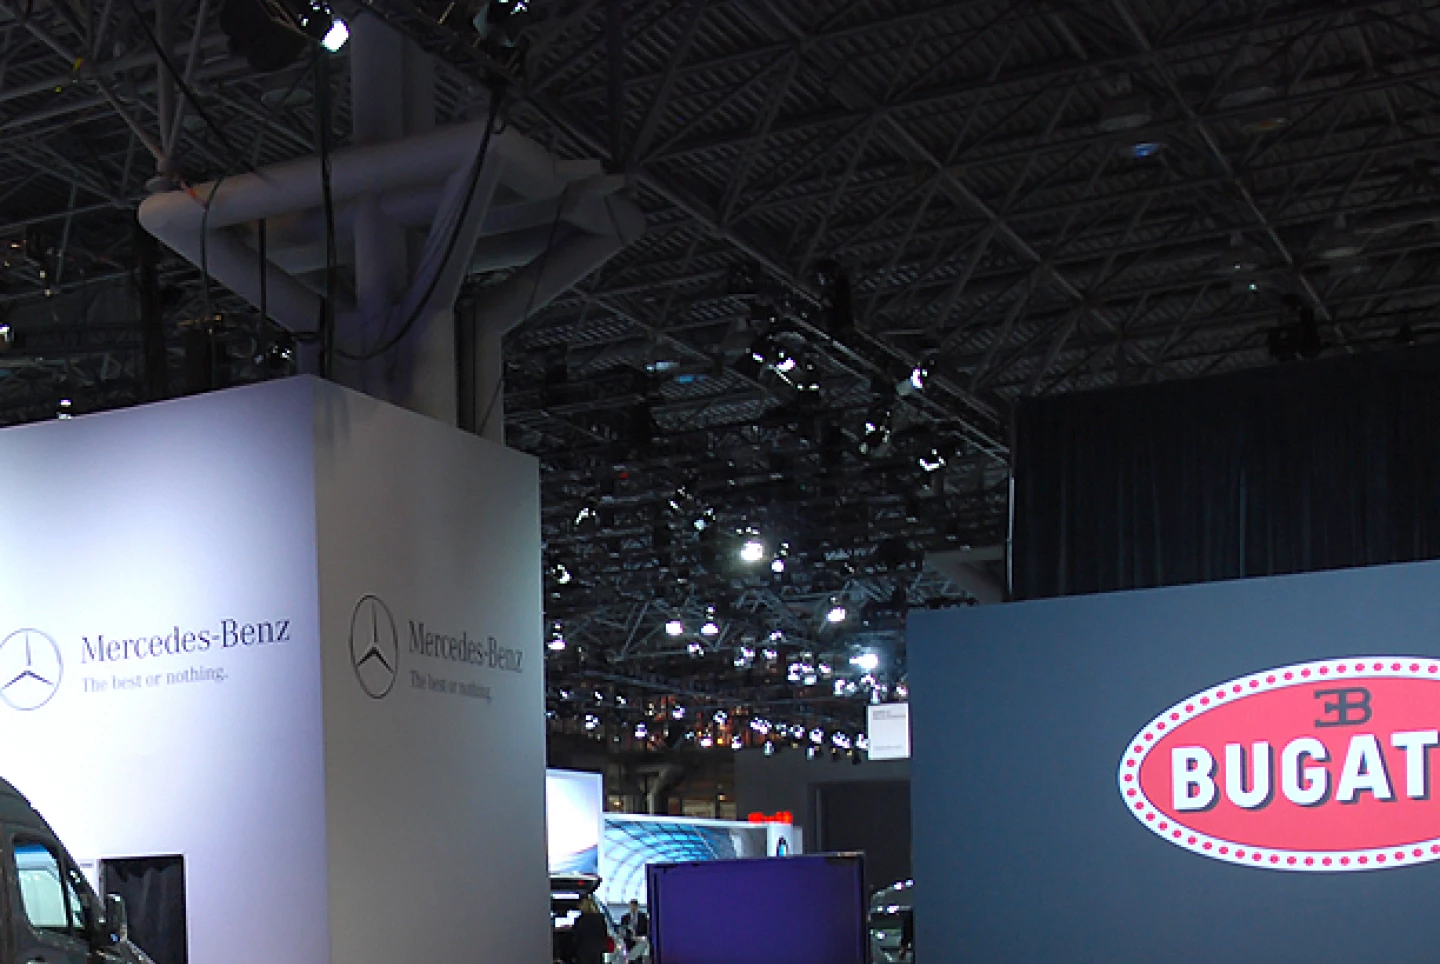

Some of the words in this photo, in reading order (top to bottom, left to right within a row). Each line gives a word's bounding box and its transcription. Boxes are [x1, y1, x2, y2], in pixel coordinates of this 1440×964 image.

[80, 618, 291, 664] Mercedes-Benz
[409, 620, 523, 674] Mercedes-Benz
[82, 677, 108, 692] The
[112, 675, 142, 689] best
[146, 675, 162, 687] or
[1171, 730, 1440, 812] BUGAT
